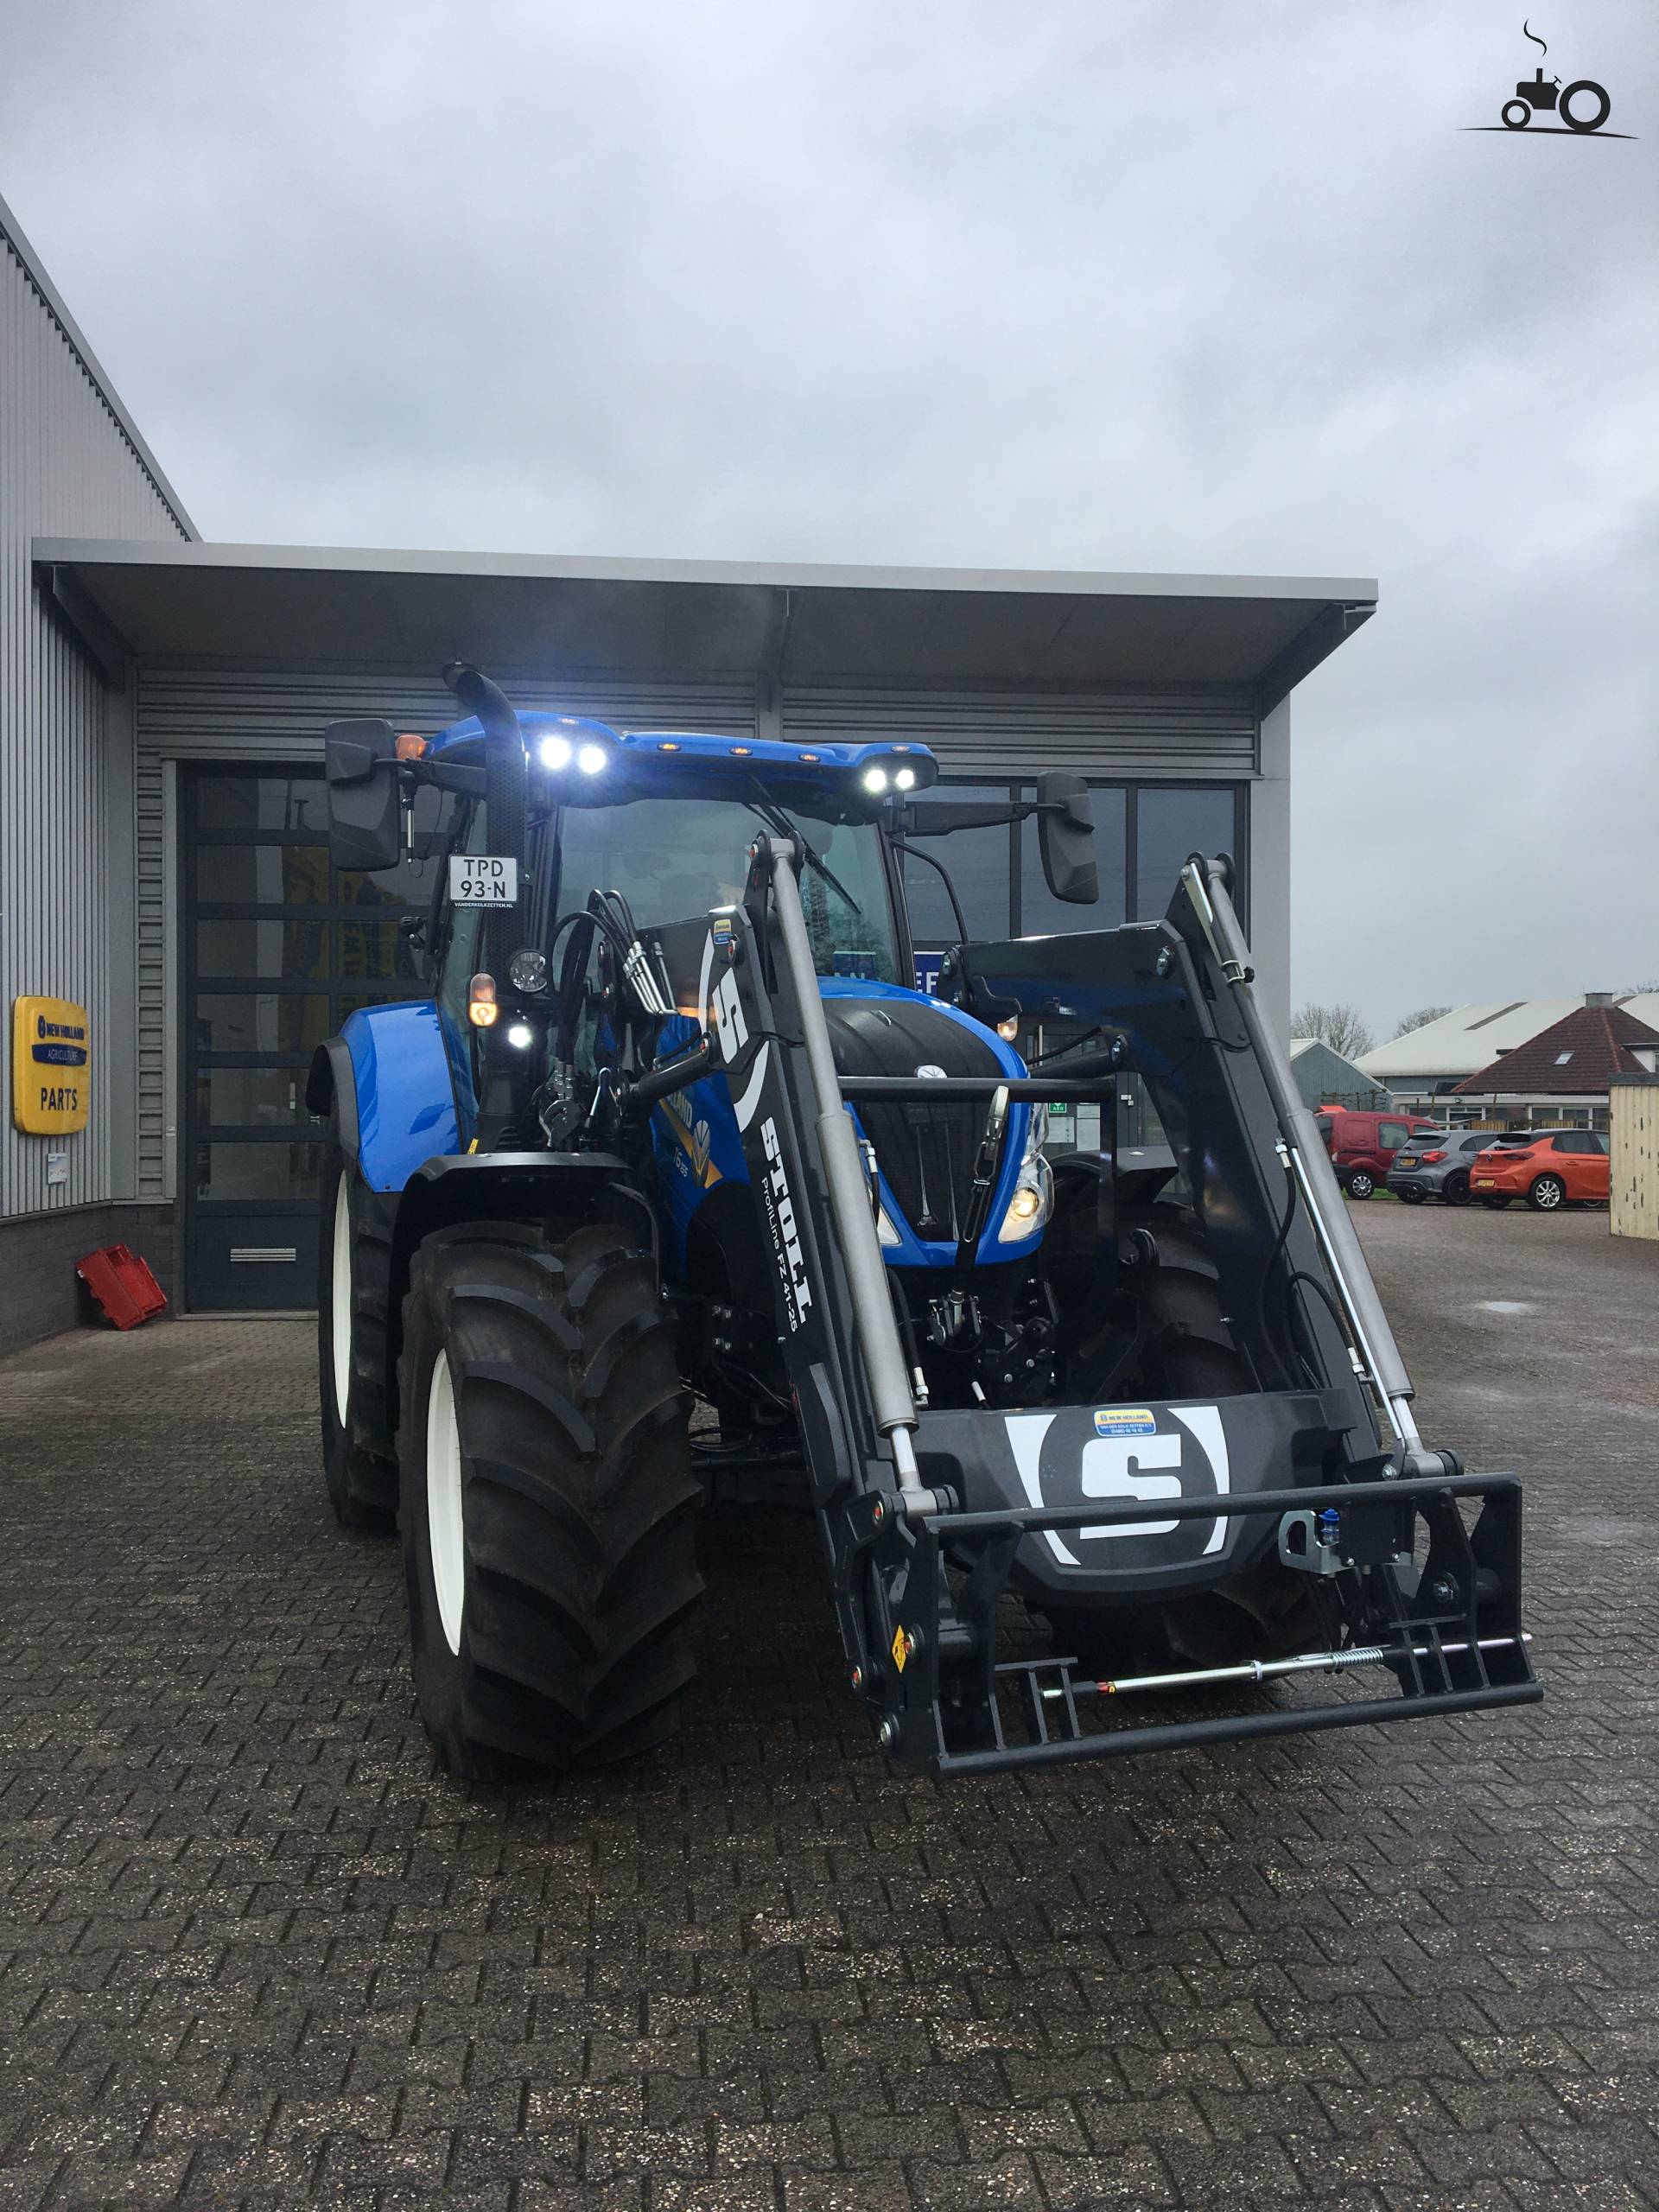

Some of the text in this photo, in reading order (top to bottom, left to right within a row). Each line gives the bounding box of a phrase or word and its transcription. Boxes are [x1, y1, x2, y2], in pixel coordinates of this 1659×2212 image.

[464, 859, 504, 877] TPD
[461, 880, 505, 899] 93-N
[47, 1022, 85, 1040] NEW HOLLAND
[48, 1048, 78, 1062] AGRICULTURE
[41, 1087, 78, 1111] PARTS
[760, 1116, 812, 1325] STOLL
[761, 1177, 798, 1332] ProfiLine FZ 41-25
